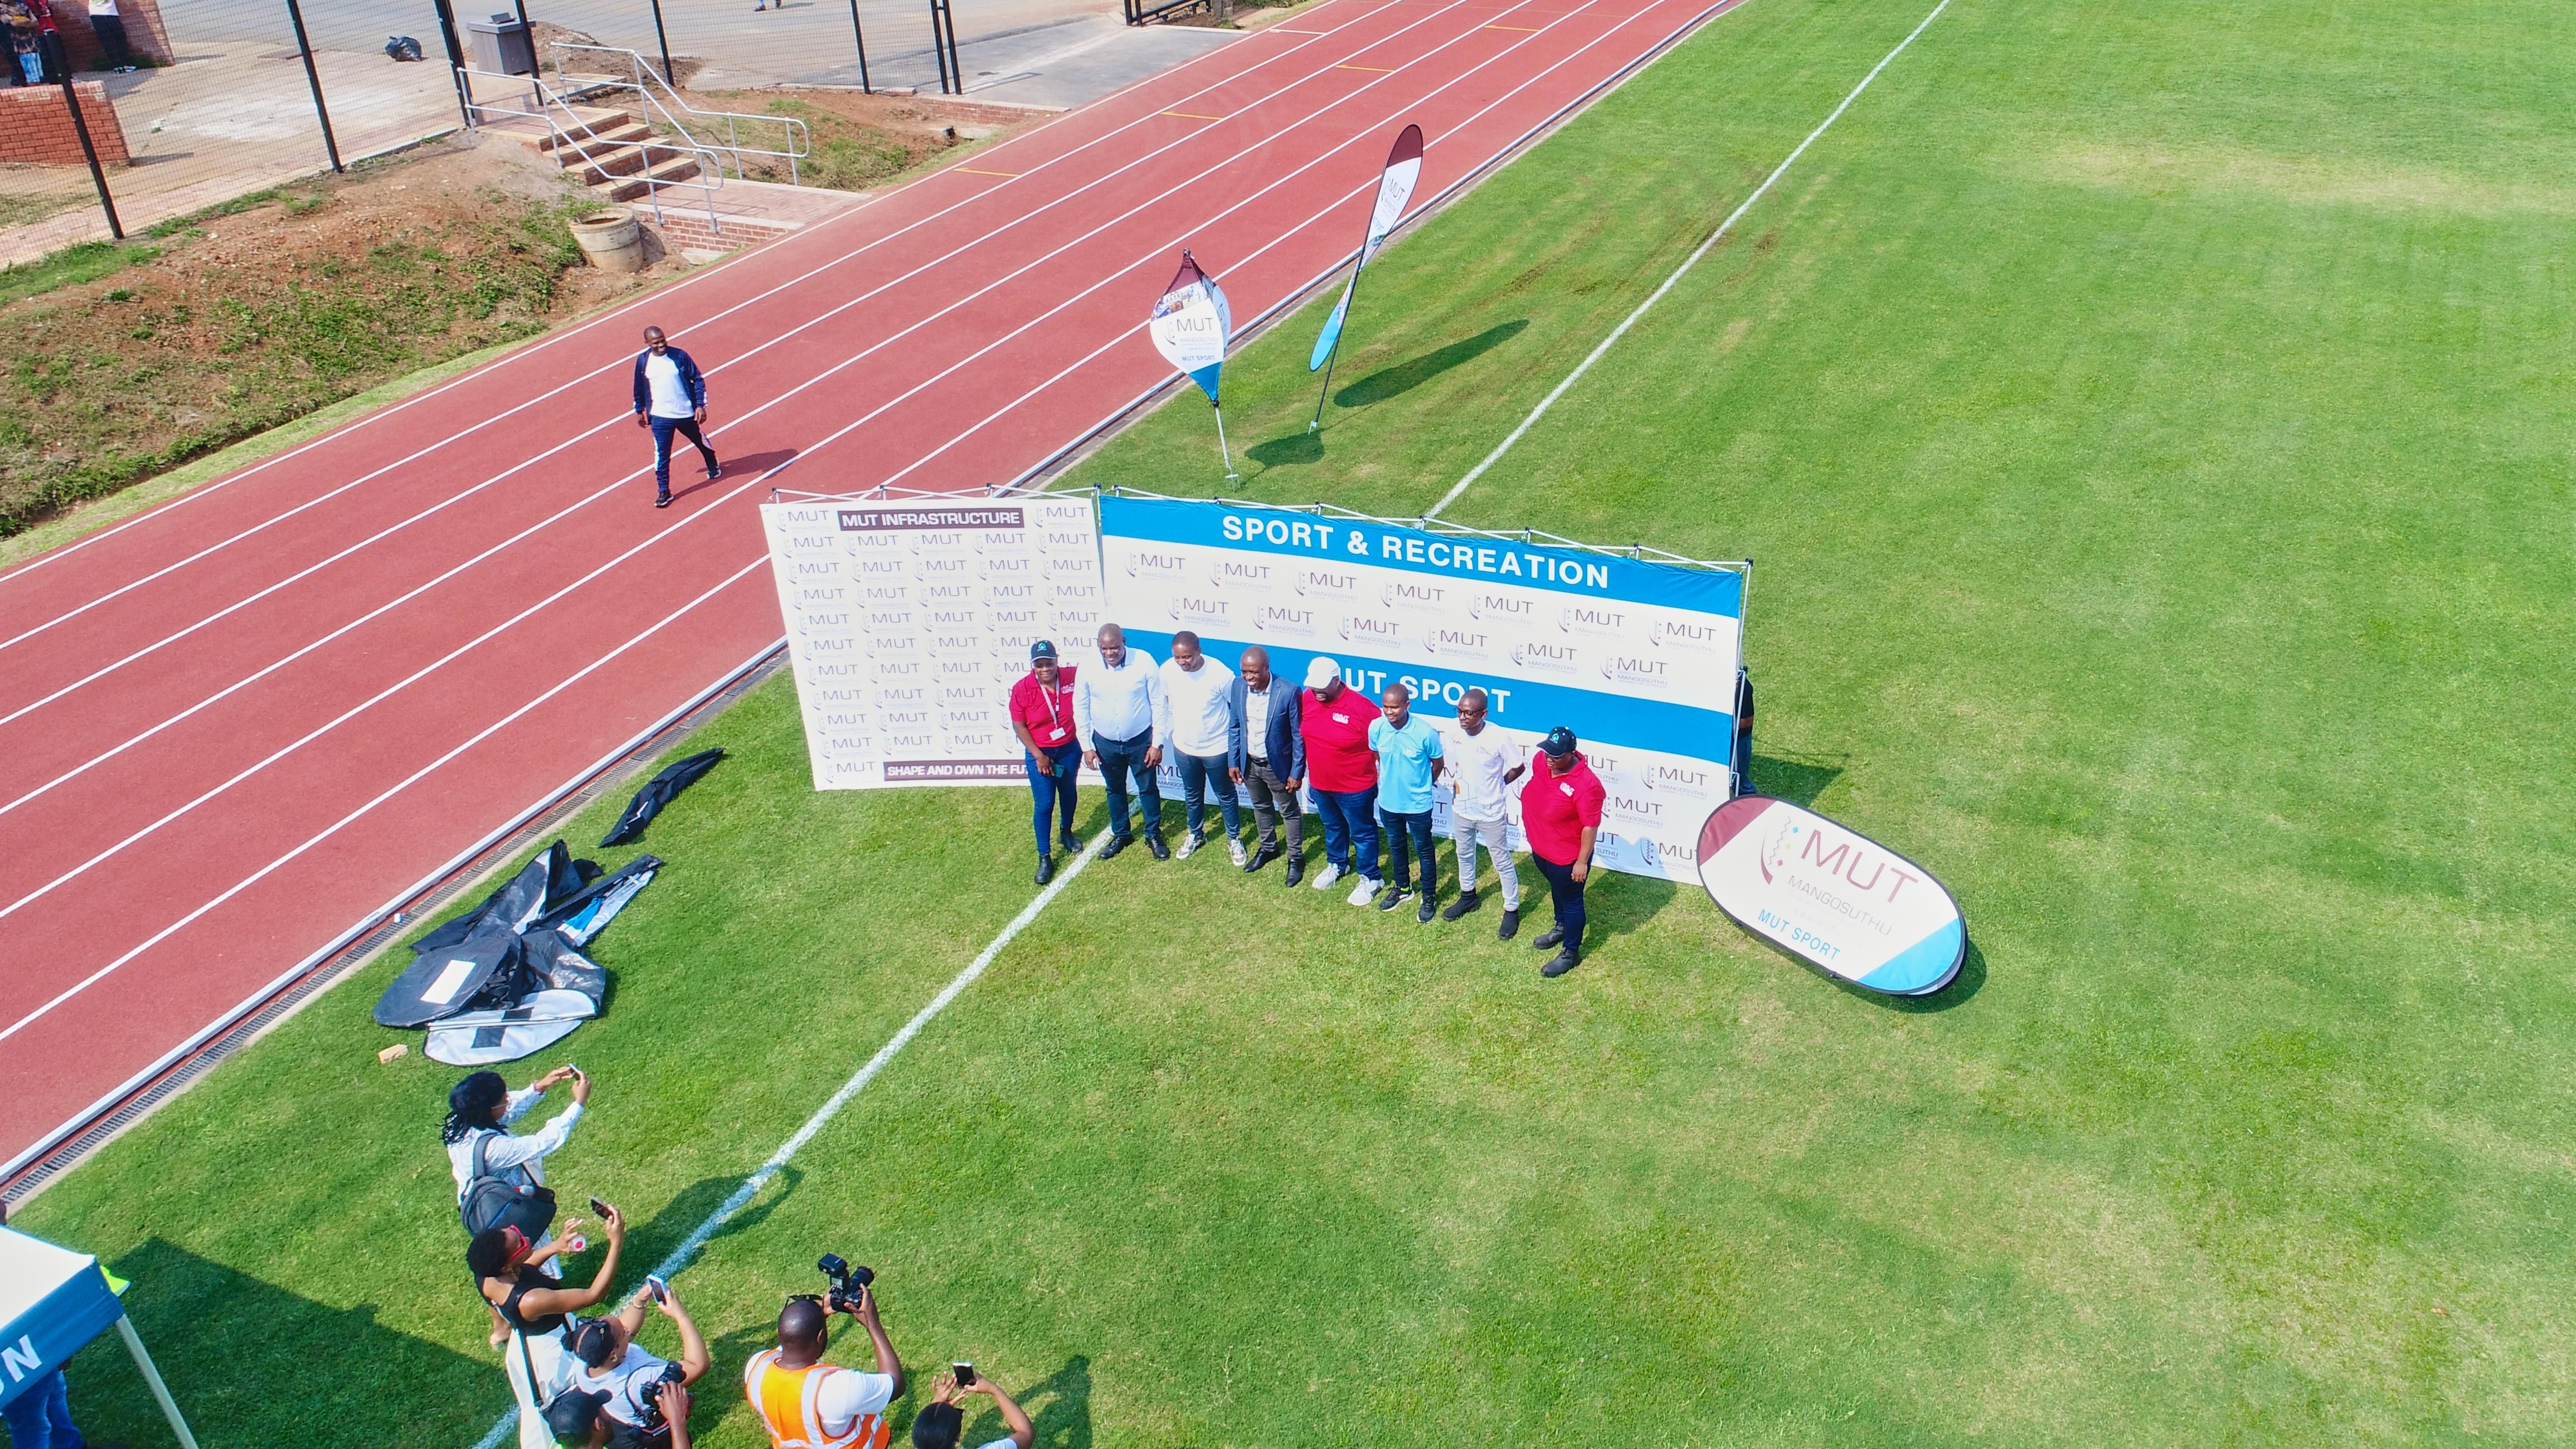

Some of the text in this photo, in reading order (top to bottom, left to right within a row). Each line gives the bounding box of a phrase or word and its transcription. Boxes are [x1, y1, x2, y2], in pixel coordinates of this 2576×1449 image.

[1388, 178, 1405, 201] MUT
[1177, 318, 1213, 332] MUT
[788, 510, 829, 521] MUT
[1047, 507, 1087, 518] MUT
[842, 512, 1020, 527] MUT INFRASTRUCTURE
[794, 537, 834, 547] MUT
[858, 535, 898, 546] MUT
[921, 534, 963, 544] MUT
[985, 533, 1025, 543] MUT
[1049, 533, 1089, 544] MUT
[1223, 516, 1608, 589] SPORT & RECREATION
[863, 562, 902, 572] MUT
[926, 560, 966, 571] MUT
[990, 560, 1030, 570] MUT
[1053, 560, 1092, 570] MUT
[1141, 554, 1185, 570] MUT
[799, 563, 839, 573] MUT
[1226, 563, 1271, 578] MUT
[1311, 572, 1357, 589] MUT
[804, 589, 844, 599] MUT
[867, 587, 907, 598] MUT
[931, 586, 970, 596] MUT
[994, 586, 1034, 596] MUT
[1057, 586, 1096, 596] MUT
[1398, 584, 1445, 601] MUT
[1184, 598, 1229, 614] MUT
[1486, 596, 1534, 614] MUT
[809, 614, 849, 624] MUT
[872, 613, 911, 623] MUT
[935, 612, 974, 622] MUT
[997, 611, 1037, 621] MUT
[1060, 611, 1099, 622] MUT
[1269, 607, 1314, 624] MUT
[1576, 609, 1625, 626] MUT
[1354, 617, 1399, 635] MUT
[1667, 623, 1716, 641] MUT
[877, 638, 916, 648] MUT
[939, 638, 978, 646] MUT
[1441, 630, 1488, 646] MUT
[814, 639, 854, 650] MUT
[1528, 643, 1577, 660] MUT
[819, 664, 858, 675] MUT
[881, 664, 920, 673] MUT
[943, 663, 981, 673] MUT
[1618, 658, 1668, 674] MUT
[823, 690, 862, 700] MUT
[885, 689, 923, 699] MUT
[946, 688, 985, 698] MUT
[1338, 667, 1511, 713] UT SPOT
[828, 714, 867, 724] MUT
[890, 713, 927, 722] MUT
[950, 712, 989, 721] MUT
[833, 737, 872, 748] MUT
[894, 736, 932, 745] MUT
[955, 735, 993, 744] MUT
[837, 762, 875, 772] MUT
[1585, 755, 1618, 771] UT
[887, 766, 925, 776] SHAPE
[927, 765, 952, 776] AND
[955, 765, 984, 775] OWN
[986, 764, 1008, 775] THE
[1660, 767, 1707, 786] MUT
[1616, 796, 1663, 815] MUT
[1596, 832, 1619, 845] UT
[1596, 848, 1618, 857] SUTHU
[1659, 843, 1697, 860] MU
[1801, 829, 1918, 903] MUT
[1787, 875, 1892, 936] MANGOSUTHU
[1758, 909, 1791, 932] MUT
[1791, 927, 1841, 960] SPORT
